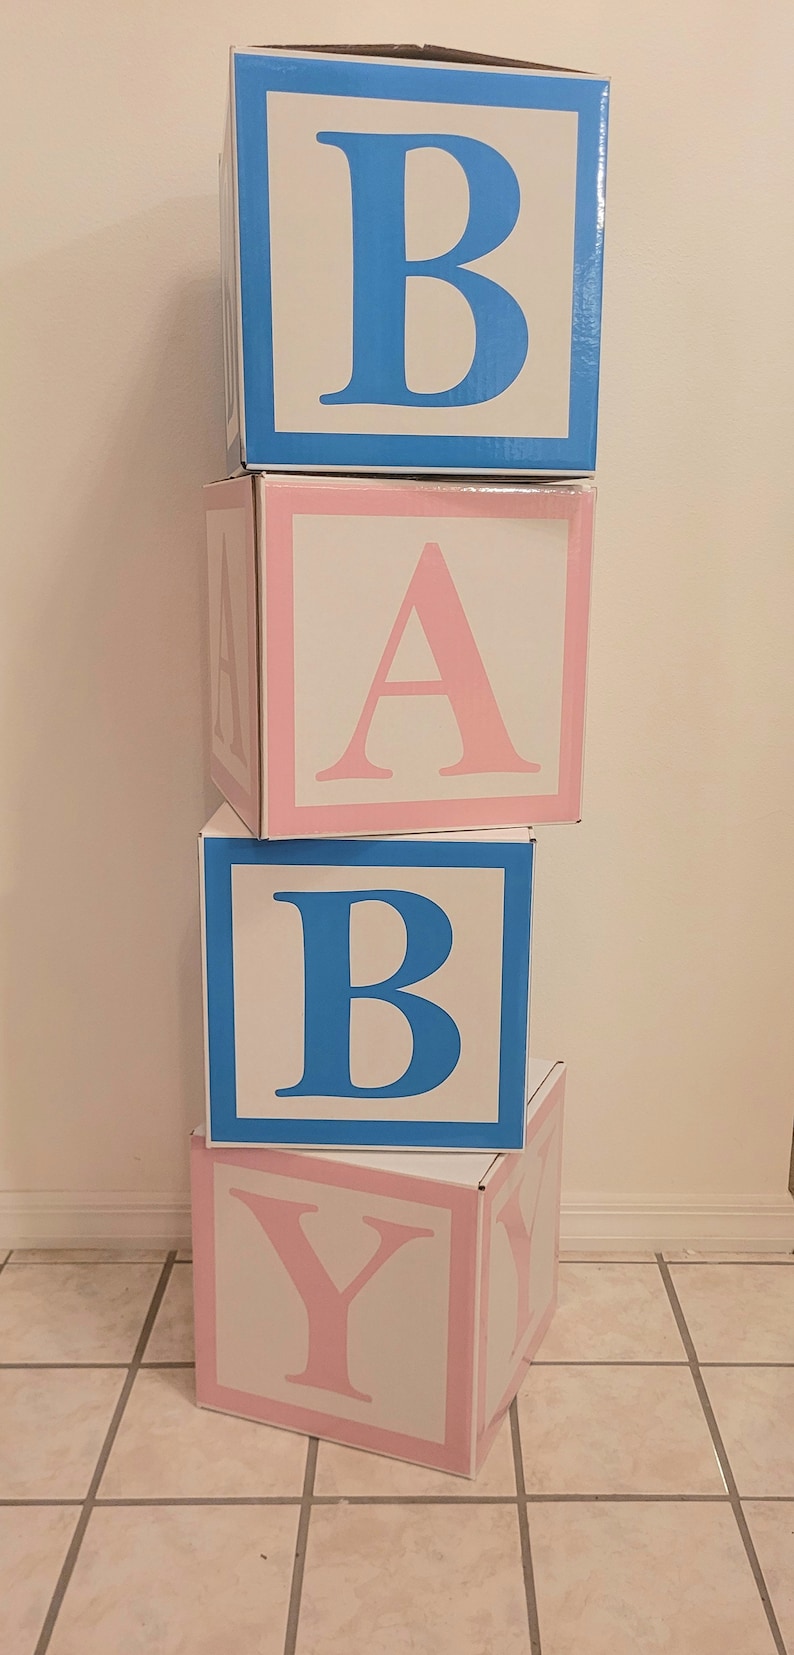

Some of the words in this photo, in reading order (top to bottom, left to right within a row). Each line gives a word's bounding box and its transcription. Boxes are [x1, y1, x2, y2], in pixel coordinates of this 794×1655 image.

[317, 131, 528, 407] B
[213, 531, 249, 769] A
[316, 543, 541, 781] A
[273, 889, 462, 1098] B
[229, 1188, 434, 1402] Y
[495, 1129, 557, 1361] Y
